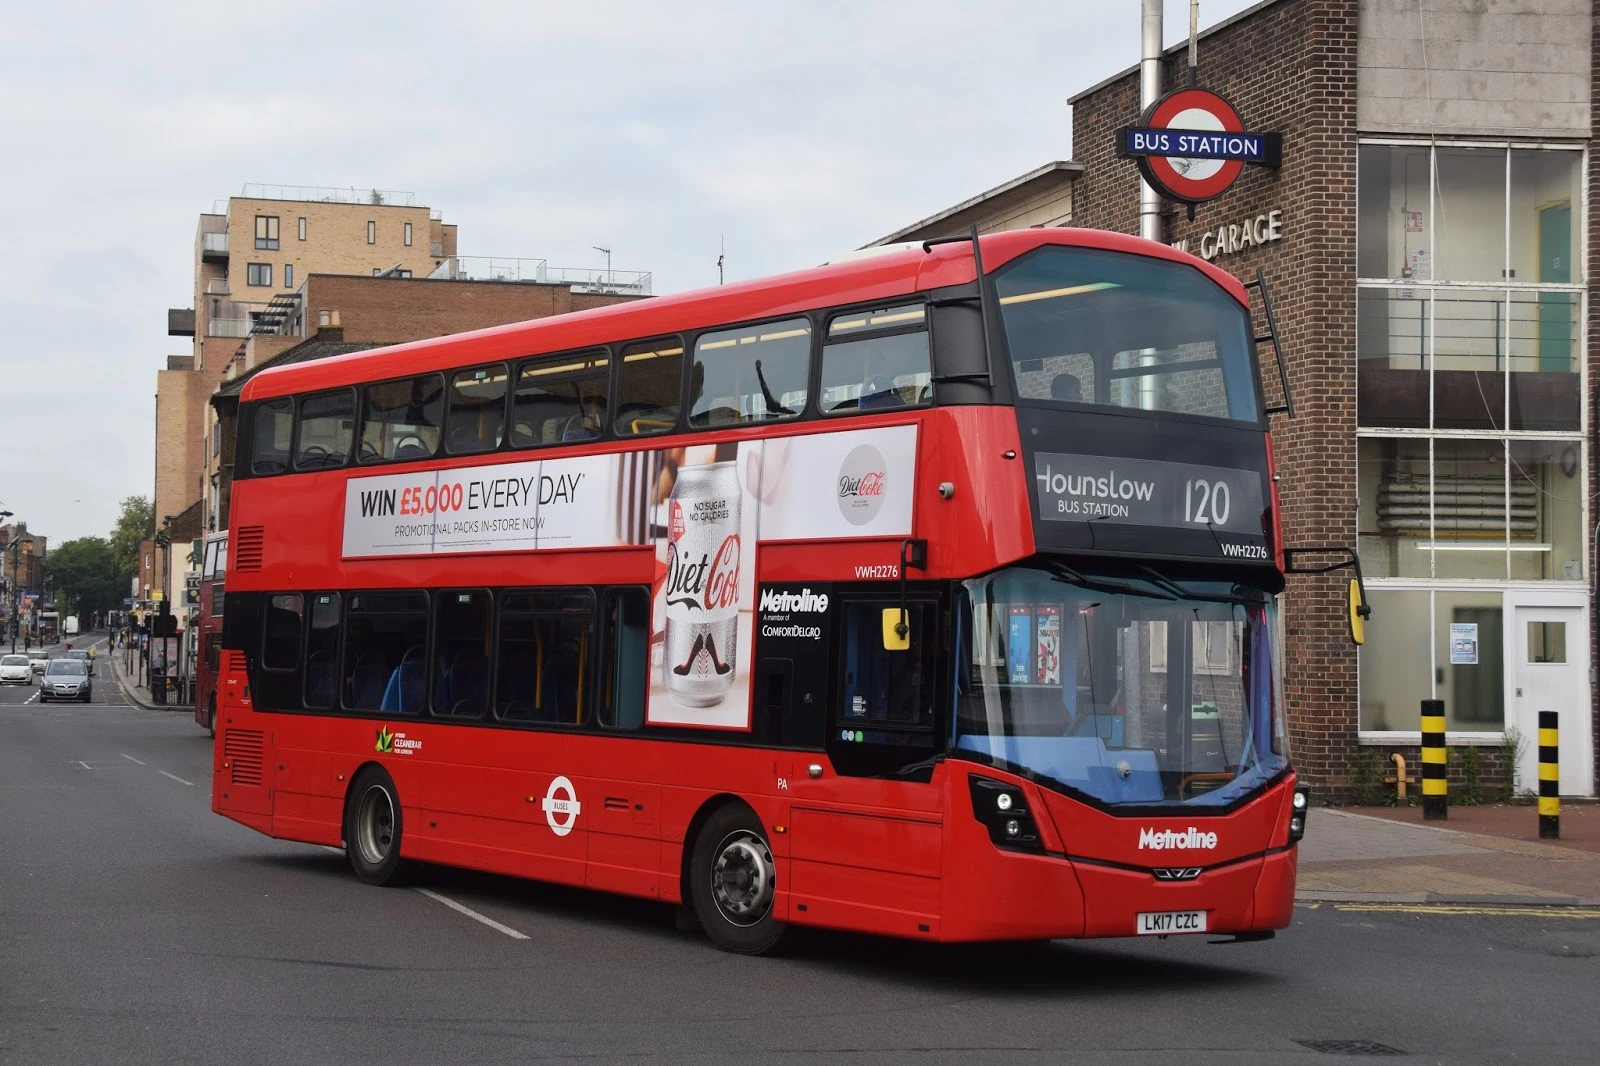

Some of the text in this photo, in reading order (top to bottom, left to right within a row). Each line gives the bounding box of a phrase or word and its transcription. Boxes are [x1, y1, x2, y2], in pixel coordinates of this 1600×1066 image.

[1134, 133, 1258, 155] BUS STATION
[1200, 210, 1282, 260] GARAGE
[839, 472, 885, 497] Diet Coke
[1036, 464, 1230, 525] Hounslow 120
[360, 489, 396, 518] WIN
[400, 483, 464, 516] £5,000
[468, 477, 534, 510] EVERY
[693, 500, 726, 511] NO SUGAR
[690, 512, 699, 521] NO
[700, 509, 730, 521] CALORIES
[1058, 500, 1129, 518] BUS STATION
[394, 516, 546, 538] PROMOTIONAL PACKS IN-STORE NOW
[1220, 543, 1267, 559] VWH2276
[666, 534, 740, 610] Diet Cok
[854, 565, 898, 578] VWH2276
[758, 588, 829, 613] Metroline
[1012, 673, 1028, 684] parking
[777, 777, 788, 790] PA
[553, 801, 569, 811] BUSES
[1138, 827, 1218, 850] Metroline
[1145, 914, 1199, 931] LK17 CZC
